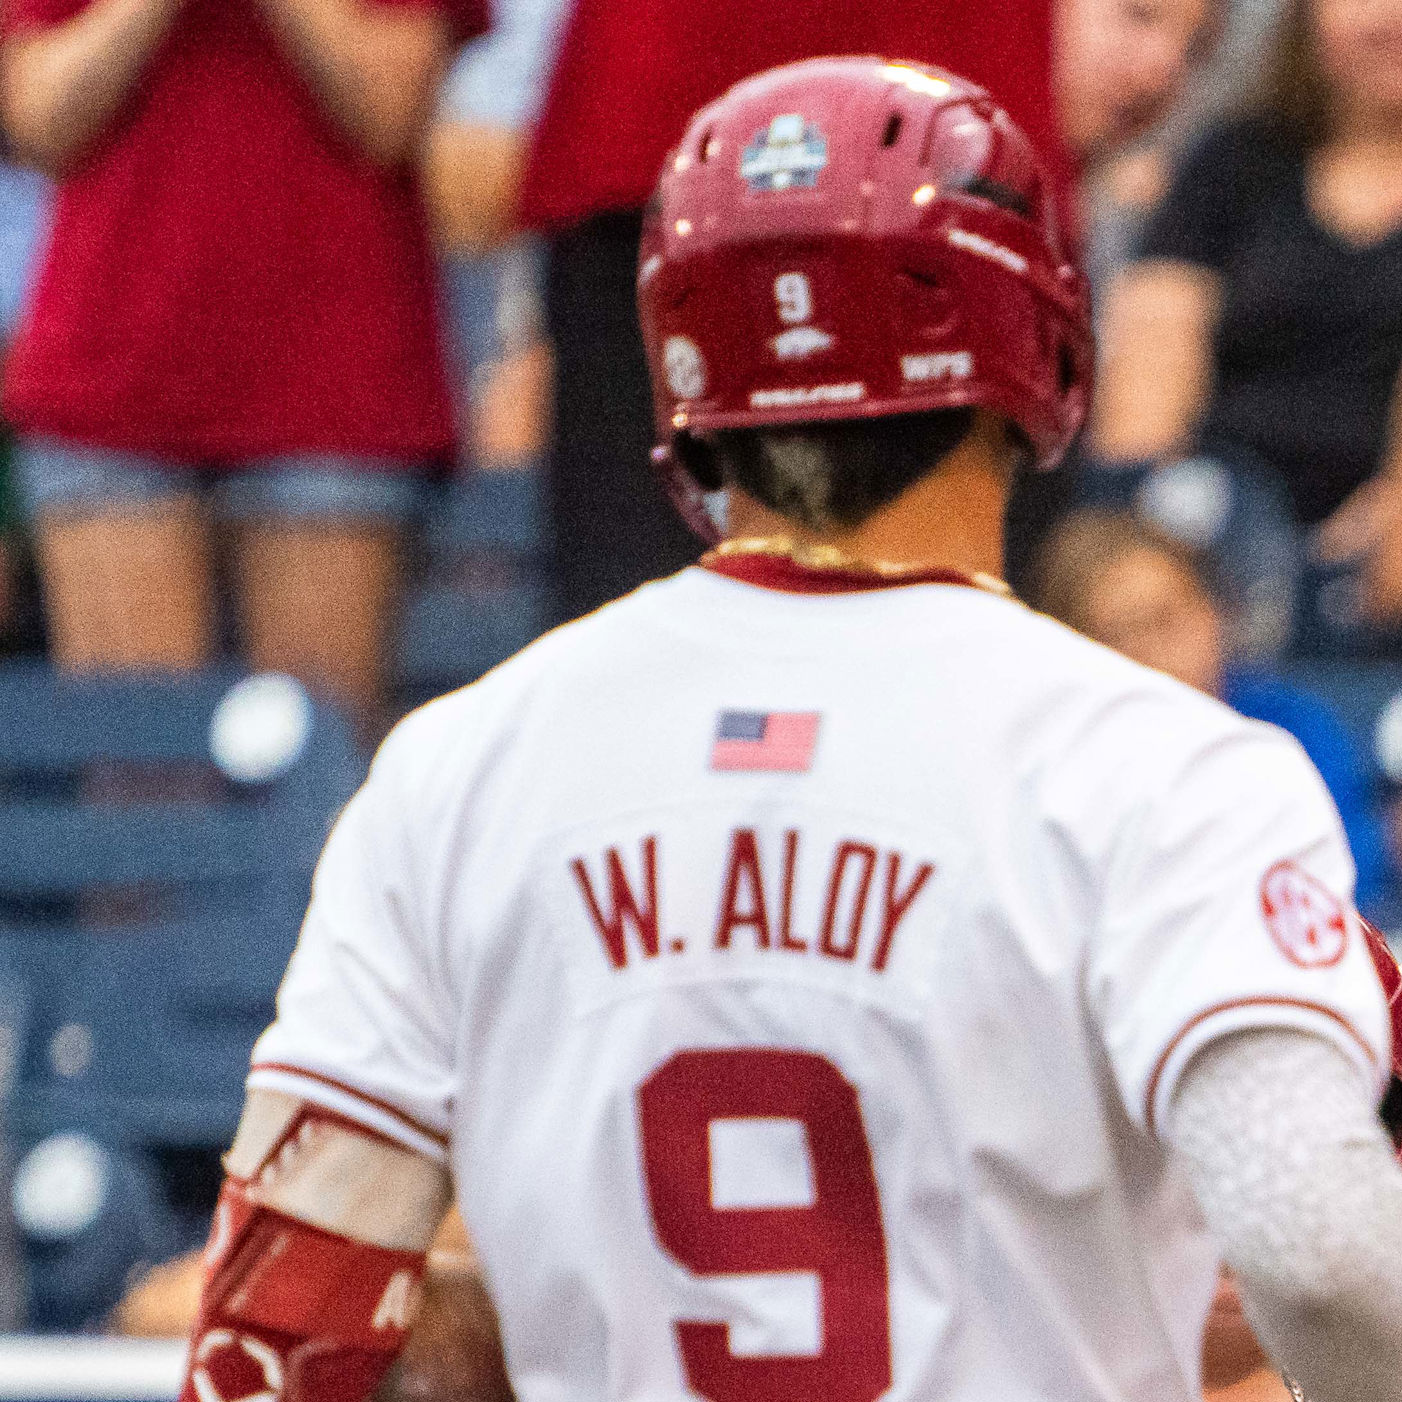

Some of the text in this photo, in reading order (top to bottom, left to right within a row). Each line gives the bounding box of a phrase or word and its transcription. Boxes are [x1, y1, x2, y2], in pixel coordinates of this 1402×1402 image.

[774, 272, 812, 324] 9
[569, 827, 937, 973] W. ALOY
